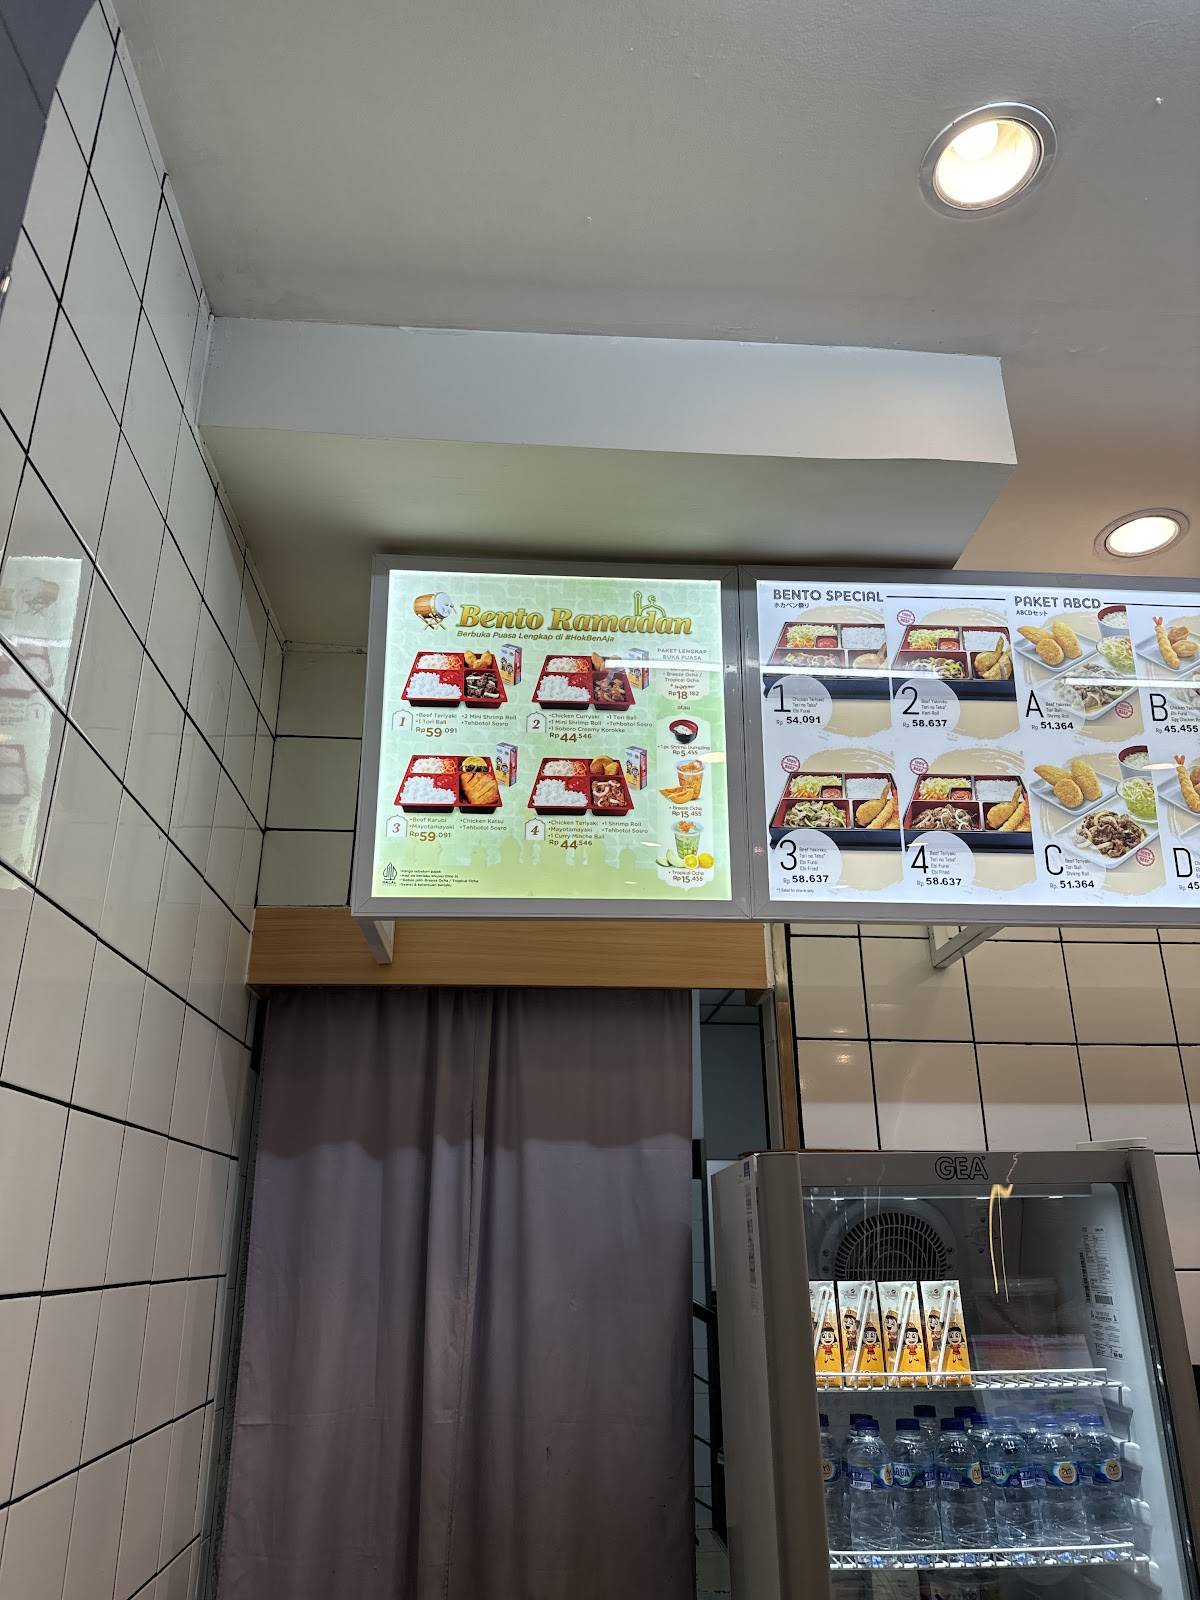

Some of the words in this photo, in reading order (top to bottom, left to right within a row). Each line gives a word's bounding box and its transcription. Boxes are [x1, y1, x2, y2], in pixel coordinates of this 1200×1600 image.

[773, 589, 822, 600] BENTO
[826, 590, 884, 602] SPECIAL
[1014, 596, 1058, 608] PAKET
[1063, 597, 1100, 608] ABCD
[456, 604, 544, 630] Bento
[547, 607, 693, 634] Ramadan
[493, 631, 516, 639] Puasa
[519, 632, 553, 640] Lengkap
[565, 634, 614, 642] #HokBenAja
[773, 684, 791, 712] 1
[902, 686, 919, 715] 2
[1026, 690, 1043, 717] A
[1150, 693, 1168, 721] B
[400, 717, 405, 726] 1
[532, 720, 540, 729] 2
[787, 716, 821, 724] 54.091
[1164, 724, 1198, 733] 45.455
[392, 823, 400, 833] 3
[531, 825, 539, 835] 4
[780, 840, 797, 870] 3
[911, 845, 928, 873] 4
[1045, 844, 1063, 875] C
[1173, 848, 1193, 877] D
[792, 875, 829, 883] 58.637
[926, 878, 962, 886] 58.637
[1060, 880, 1094, 888] 51.364
[935, 1156, 988, 1180] GEA
